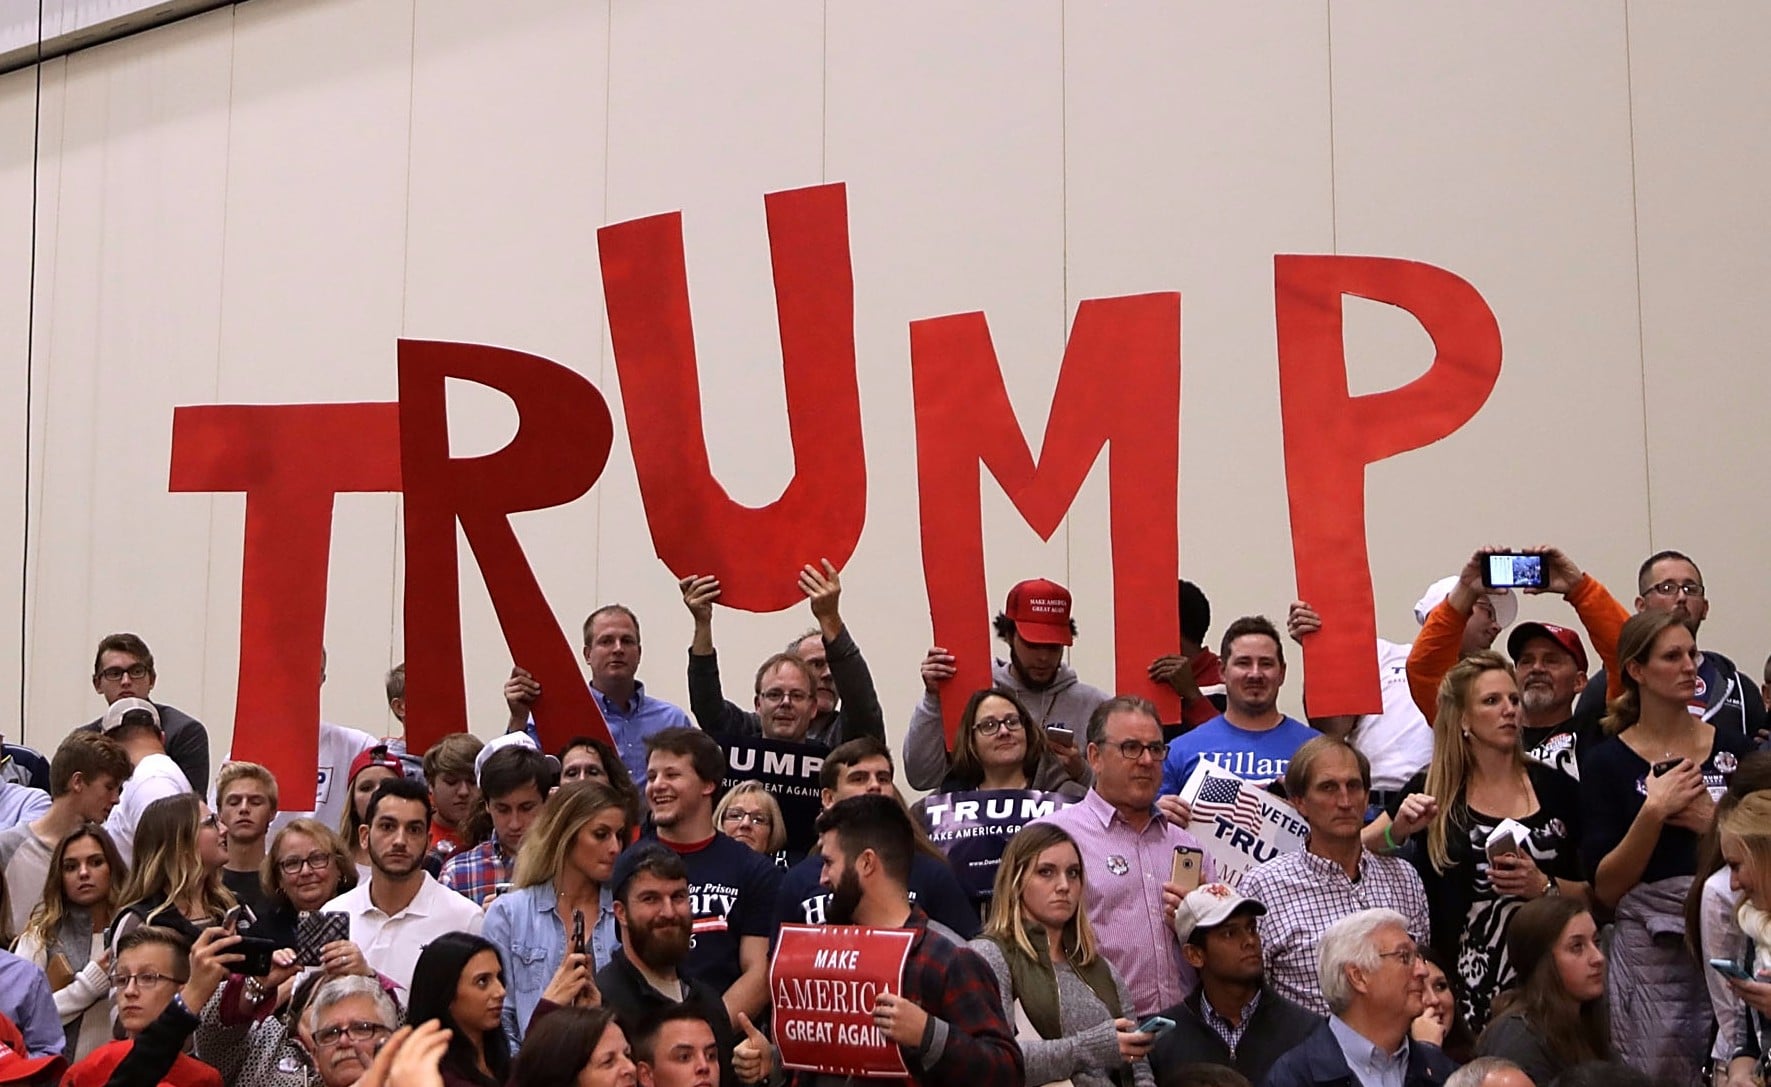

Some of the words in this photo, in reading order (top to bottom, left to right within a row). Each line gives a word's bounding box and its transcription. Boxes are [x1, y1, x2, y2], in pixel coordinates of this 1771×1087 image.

[168, 182, 1503, 812] TRUMP
[786, 785, 820, 798] AGAIN
[926, 799, 1072, 826] TRUM
[955, 825, 1003, 839] AMERICA
[703, 883, 739, 896] Prison
[813, 949, 860, 970] MAKE
[785, 1019, 834, 1045] GREAT
